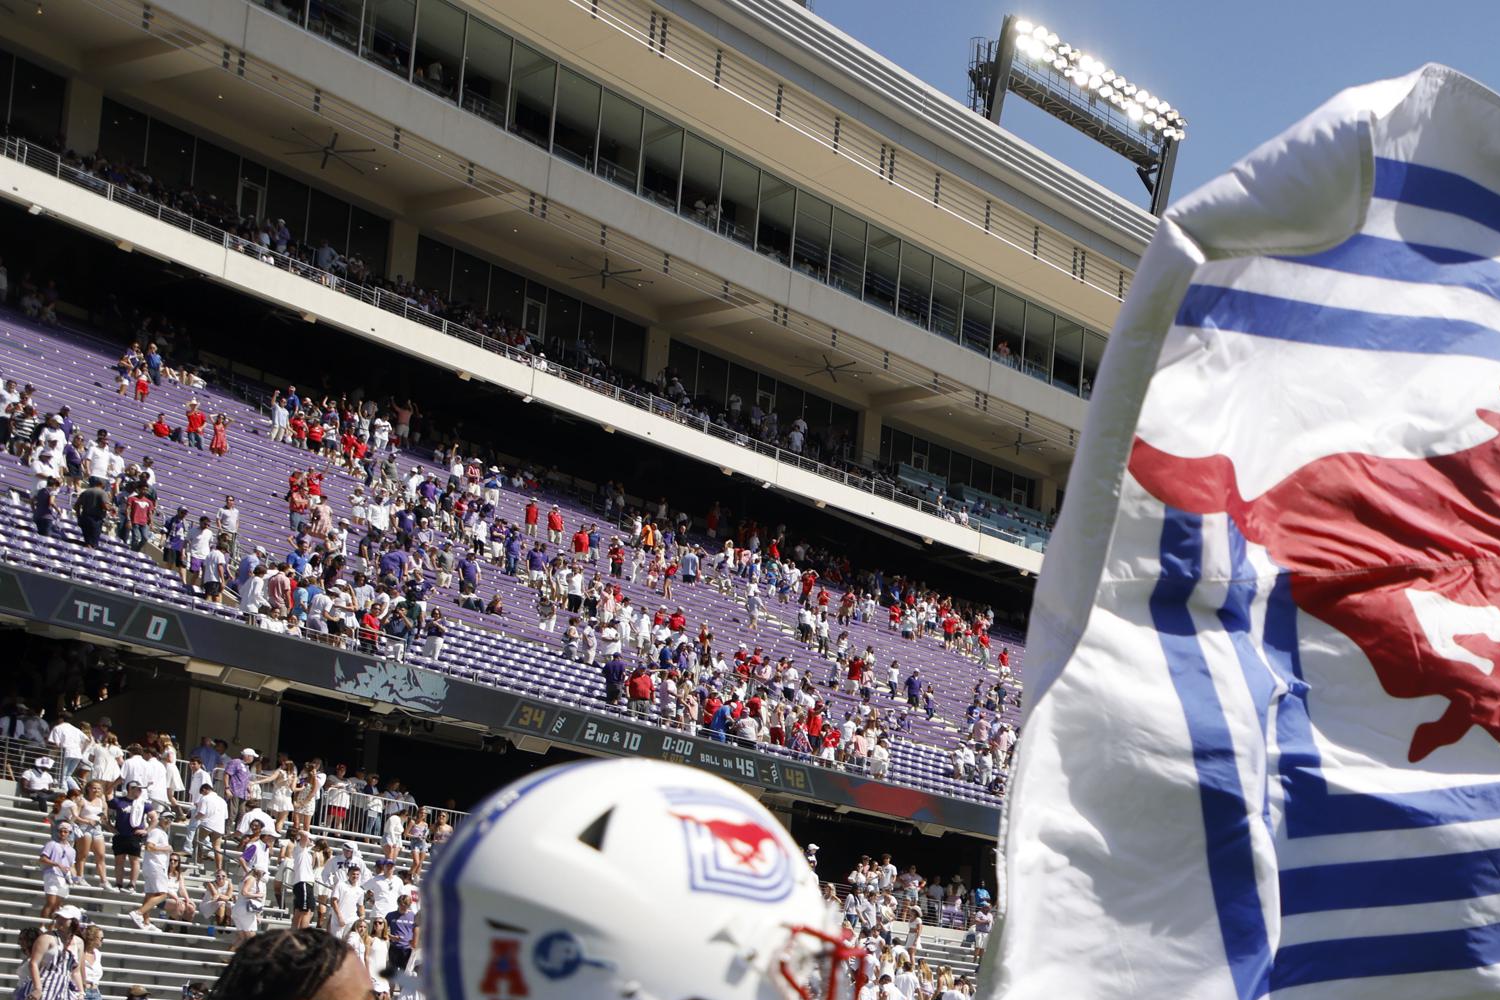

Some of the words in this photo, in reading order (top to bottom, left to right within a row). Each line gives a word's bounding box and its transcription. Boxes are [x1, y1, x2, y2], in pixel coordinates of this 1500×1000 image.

[74, 600, 116, 627] TFL
[146, 615, 169, 641] 0
[518, 705, 546, 729] 34
[551, 715, 567, 734] TOL
[584, 722, 610, 744] 2ND
[623, 731, 642, 751] 10
[661, 736, 694, 756] 0:00
[700, 753, 720, 766] BALL
[723, 758, 733, 769] ON
[736, 757, 756, 779] 45
[770, 762, 780, 784] TOL
[784, 767, 806, 789] 42
